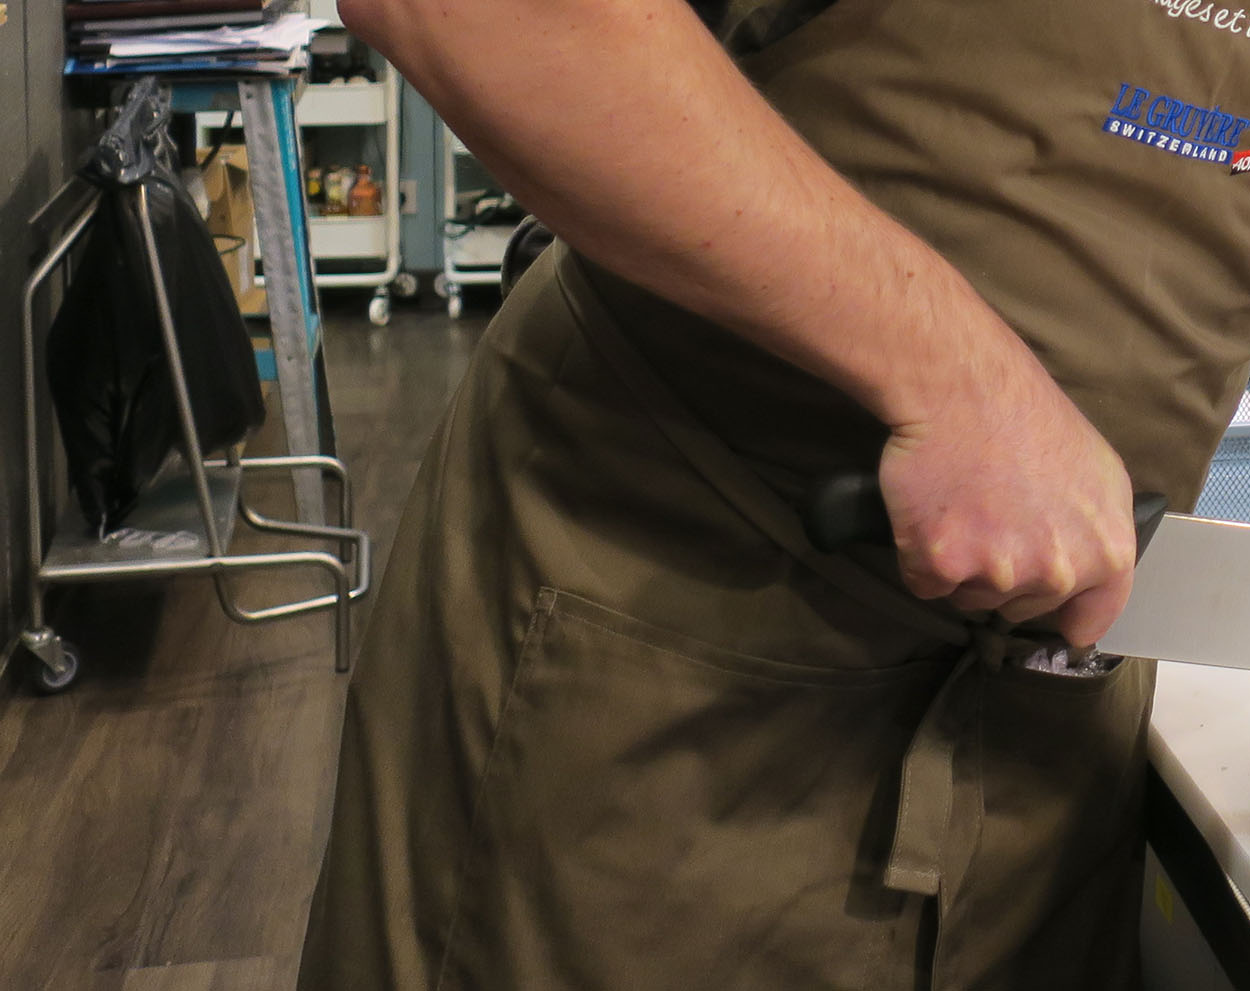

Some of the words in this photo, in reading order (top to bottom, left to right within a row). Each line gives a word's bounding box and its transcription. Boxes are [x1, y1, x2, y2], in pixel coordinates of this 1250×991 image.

[1213, 8, 1247, 34] et
[1110, 82, 1150, 121] LE
[1147, 94, 1249, 148] GRUYÈRE
[1108, 119, 1229, 164] SWITZERLAND
